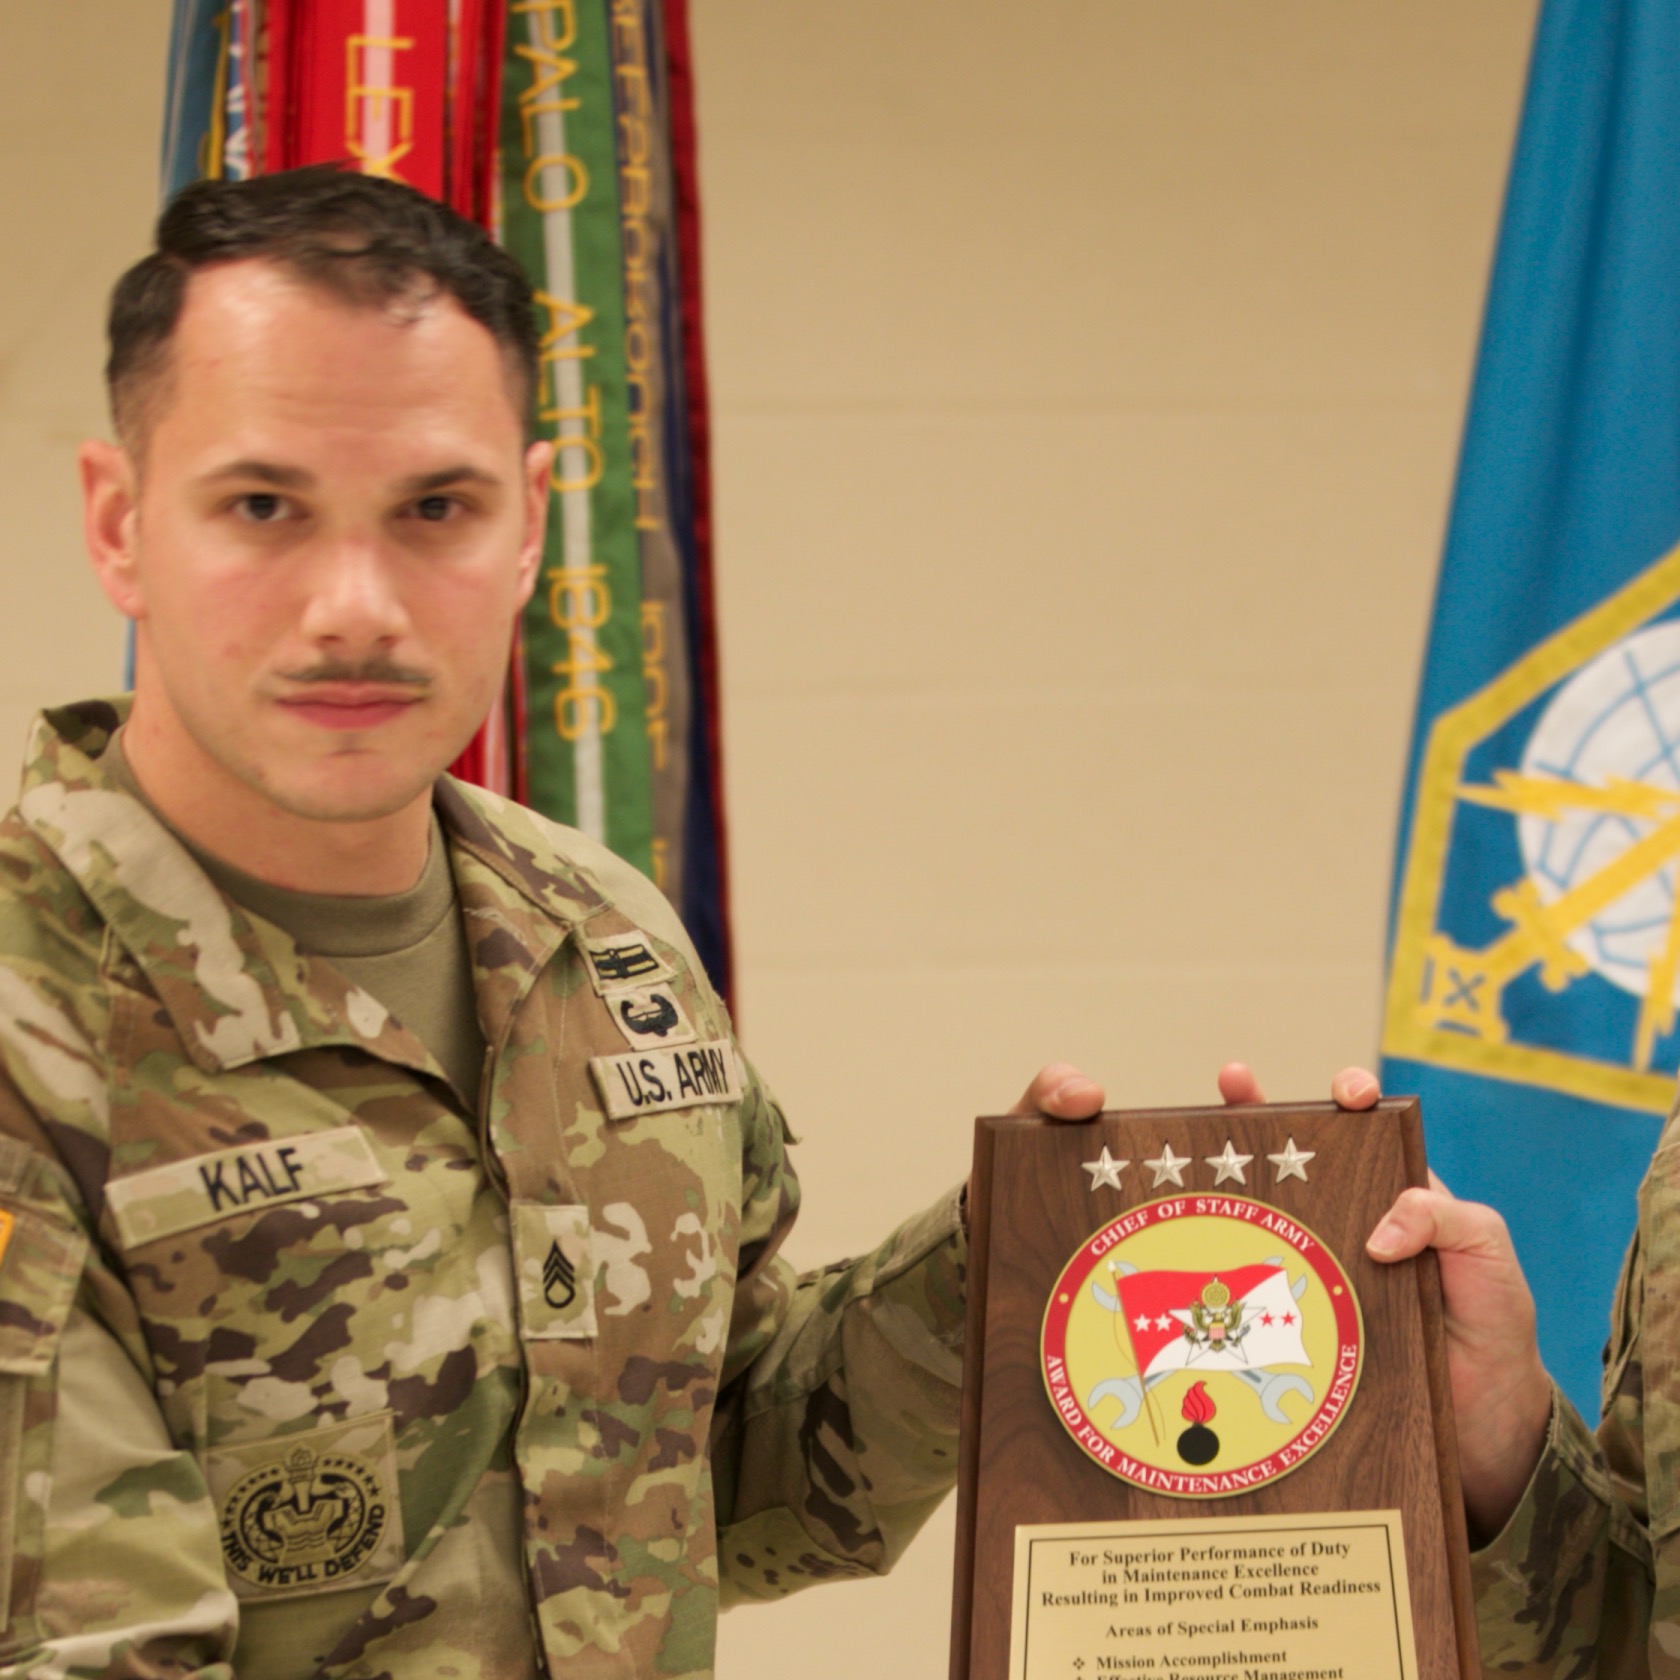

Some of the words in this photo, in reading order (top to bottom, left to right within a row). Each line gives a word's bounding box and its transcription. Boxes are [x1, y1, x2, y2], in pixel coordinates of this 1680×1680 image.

[510, 0, 590, 214] PALO
[532, 289, 606, 492] ALTO
[547, 564, 618, 742] 1846
[616, 1058, 673, 1107] U.S.
[673, 1047, 730, 1100] ARMY
[198, 1144, 304, 1213] KALF
[1089, 1210, 1150, 1257] CHIEF
[1156, 1199, 1187, 1220] OF
[1195, 1198, 1260, 1221] STAFF
[1260, 1212, 1315, 1252] ARMY
[1046, 1354, 1082, 1427] AWARD
[1077, 1423, 1115, 1464] FOR
[1116, 1456, 1277, 1493] MAINTENANCE
[1278, 1343, 1358, 1467] EXCELLENCE
[221, 1531, 253, 1572] THIS
[324, 1503, 386, 1577] DEFEND
[1069, 1551, 1098, 1566] For
[1103, 1548, 1174, 1568] Superior
[1179, 1546, 1285, 1561] Performance
[1289, 1542, 1306, 1557] of
[1310, 1541, 1351, 1559] Duty
[1041, 1589, 1119, 1608] Resulting
[1123, 1588, 1138, 1603] in
[1144, 1584, 1224, 1605] Improved
[1229, 1582, 1294, 1599] Combat
[1299, 1579, 1381, 1596] Readiness
[1102, 1569, 1117, 1584] in
[1123, 1567, 1228, 1584] Maintenance
[1234, 1563, 1319, 1579] Excellence
[1105, 1624, 1152, 1638] Areas
[1157, 1621, 1173, 1636] of
[1177, 1619, 1235, 1639] Special
[1240, 1615, 1319, 1635] Emphasis
[1097, 1655, 1155, 1670] Mission
[1159, 1650, 1287, 1670] Accomplishment
